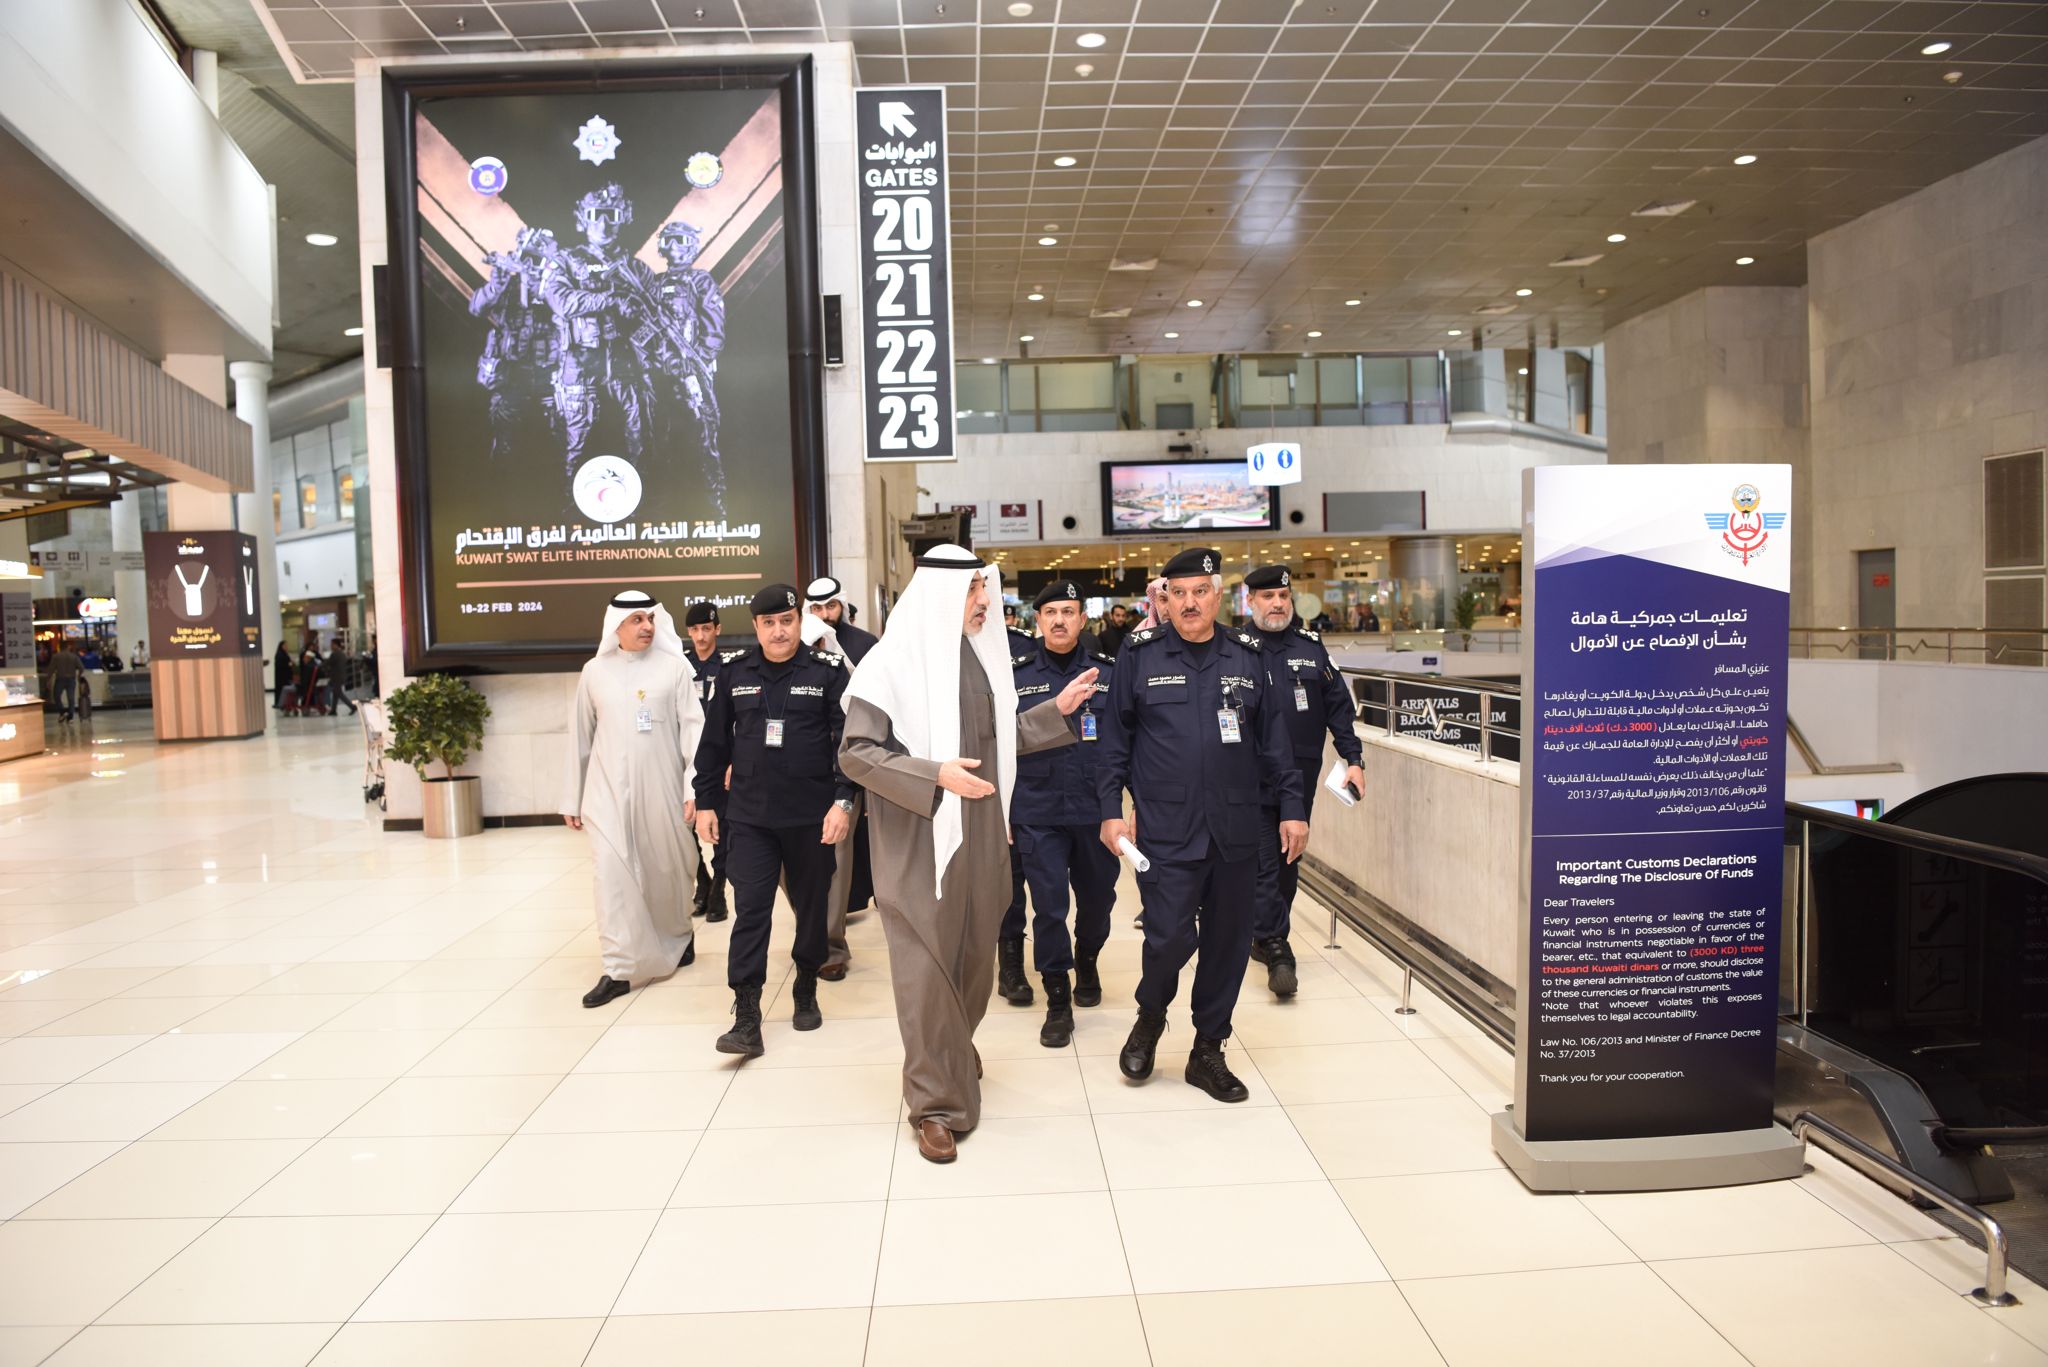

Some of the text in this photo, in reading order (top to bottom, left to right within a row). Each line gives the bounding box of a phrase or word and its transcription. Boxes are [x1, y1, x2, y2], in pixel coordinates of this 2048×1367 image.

[865, 141, 936, 165] البوابات
[865, 168, 938, 187] GATES
[872, 196, 933, 251] 20
[875, 262, 931, 317] 21
[876, 329, 938, 385] 22
[878, 394, 940, 450] 23
[526, 525, 566, 547] لفرق
[571, 523, 636, 546] العالمية
[640, 521, 688, 543] النخبة
[692, 520, 761, 542] مسابقة
[456, 544, 760, 565] KUWAIT SWAT ELITE INTERNATIONAL COMPETITION
[492, 602, 512, 612] FEB
[518, 601, 543, 612] 2024
[1570, 608, 1747, 628] تعليمات جمركية هامة
[1570, 630, 1746, 652] بشأن الإفصاح عن الأموال
[1713, 663, 1769, 677] عزيزي المسافر
[1556, 854, 1757, 873] Important Customs Declarations
[1559, 866, 1753, 886] Regarding The Disclosure Of Funds
[1543, 897, 1615, 907] Dear Travelers
[1543, 916, 1570, 926] Every
[1575, 916, 1608, 925] person
[1613, 913, 1653, 923] entering
[1672, 911, 1704, 921] leaving
[1708, 910, 1725, 919] the
[1728, 909, 1751, 918] state
[1755, 907, 1766, 916] of
[1542, 928, 1575, 937] Kuwait
[1581, 927, 1602, 936] who
[1607, 926, 1615, 935] is
[1620, 926, 1629, 935] in
[1635, 924, 1686, 936] possession
[1690, 923, 1701, 932] of
[1705, 921, 1750, 932] currencies
[1542, 932, 1764, 949] financial instruments negotiable in favor of the
[1601, 951, 1621, 960] that
[1624, 949, 1673, 960] equivalent
[1676, 949, 1687, 957] to
[1689, 947, 1717, 957] (3000
[1720, 946, 1737, 954] KD)
[1740, 945, 1764, 953] three
[1542, 964, 1589, 973] thousand
[1591, 963, 1627, 972] Kuwaiti
[1629, 963, 1659, 971] dinars
[1699, 958, 1728, 968] should
[1730, 956, 1764, 966] disclose
[1541, 968, 1763, 987] to the general administration of customs the value
[1578, 1001, 1599, 1009] that
[1608, 1000, 1649, 1008] whoever
[1657, 997, 1693, 1006] violates
[1701, 995, 1718, 1004] this
[1726, 993, 1762, 1003] exposes
[1540, 1013, 1595, 1022] themselves
[1597, 1013, 1608, 1021] to
[1609, 1011, 1631, 1022] legal
